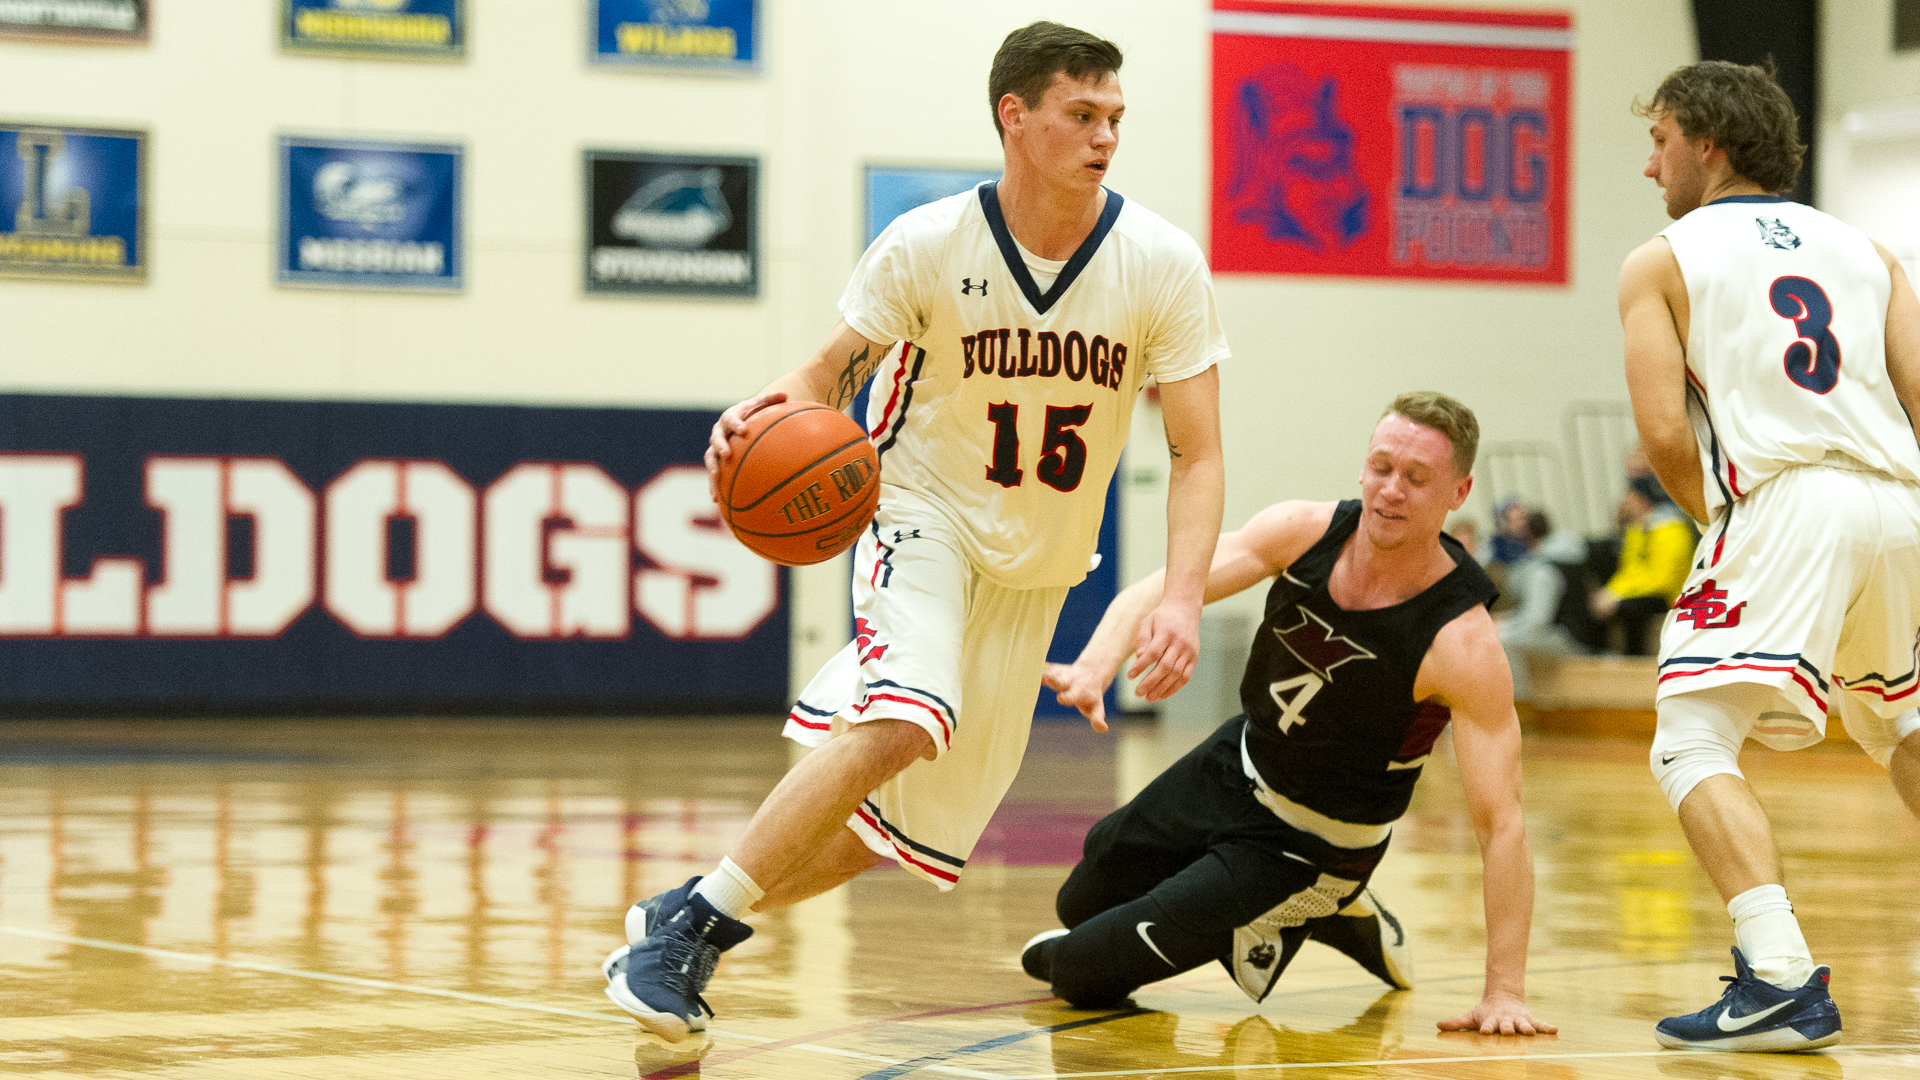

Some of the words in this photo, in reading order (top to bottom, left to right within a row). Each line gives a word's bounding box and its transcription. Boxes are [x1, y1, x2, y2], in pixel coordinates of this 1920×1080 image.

[1398, 103, 1548, 205] DOG
[961, 328, 1127, 391] BULLDOGS
[1769, 275, 1841, 395] 3
[985, 400, 1094, 492] 15
[778, 481, 831, 525] THE
[1269, 672, 1324, 736] 4
